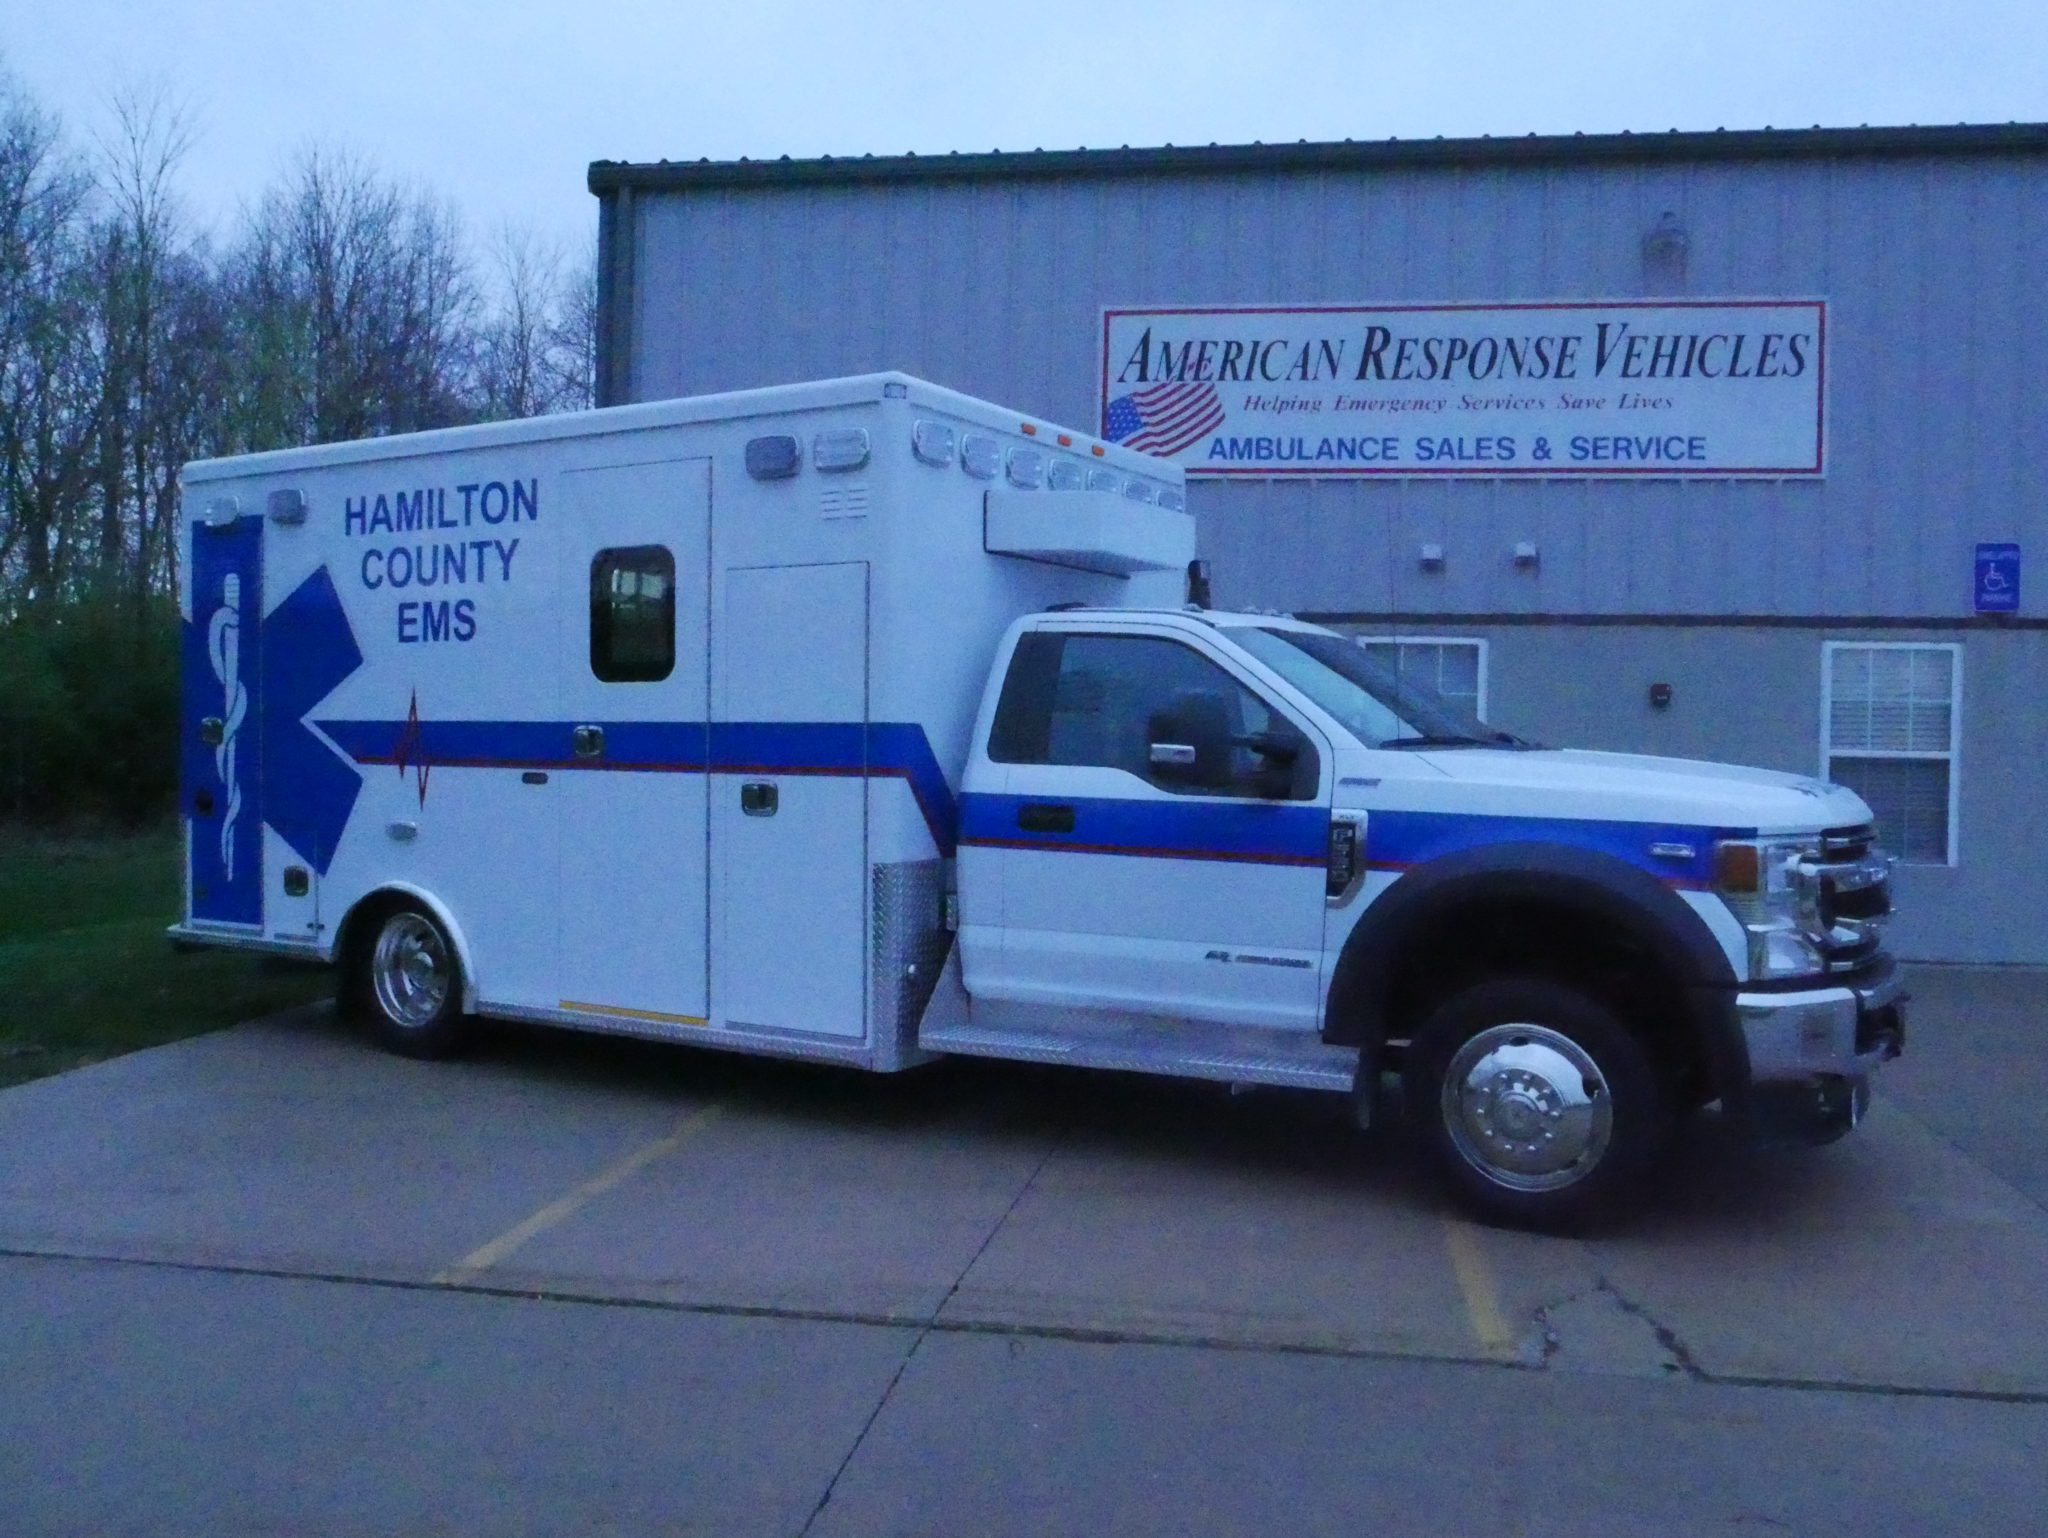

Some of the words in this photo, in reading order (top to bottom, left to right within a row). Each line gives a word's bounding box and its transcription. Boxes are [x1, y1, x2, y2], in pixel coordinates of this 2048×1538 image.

[1117, 326, 1345, 382] AMERICAN
[1355, 325, 1582, 380] RESPONSE
[1595, 322, 1810, 378] VEHICLES
[1243, 394, 1322, 414] Helping
[1334, 394, 1447, 413] Emergency
[1457, 393, 1545, 410] Services
[1557, 392, 1606, 410] Save
[1618, 392, 1673, 409] Lives
[1208, 437, 1399, 460] AMBULANCE
[1415, 436, 1516, 461] SALES
[1532, 436, 1552, 460] &
[1569, 435, 1706, 461] SERVICE
[345, 479, 538, 535] HAMILTON
[361, 538, 520, 590] COUNTY
[398, 599, 476, 643] EMS
